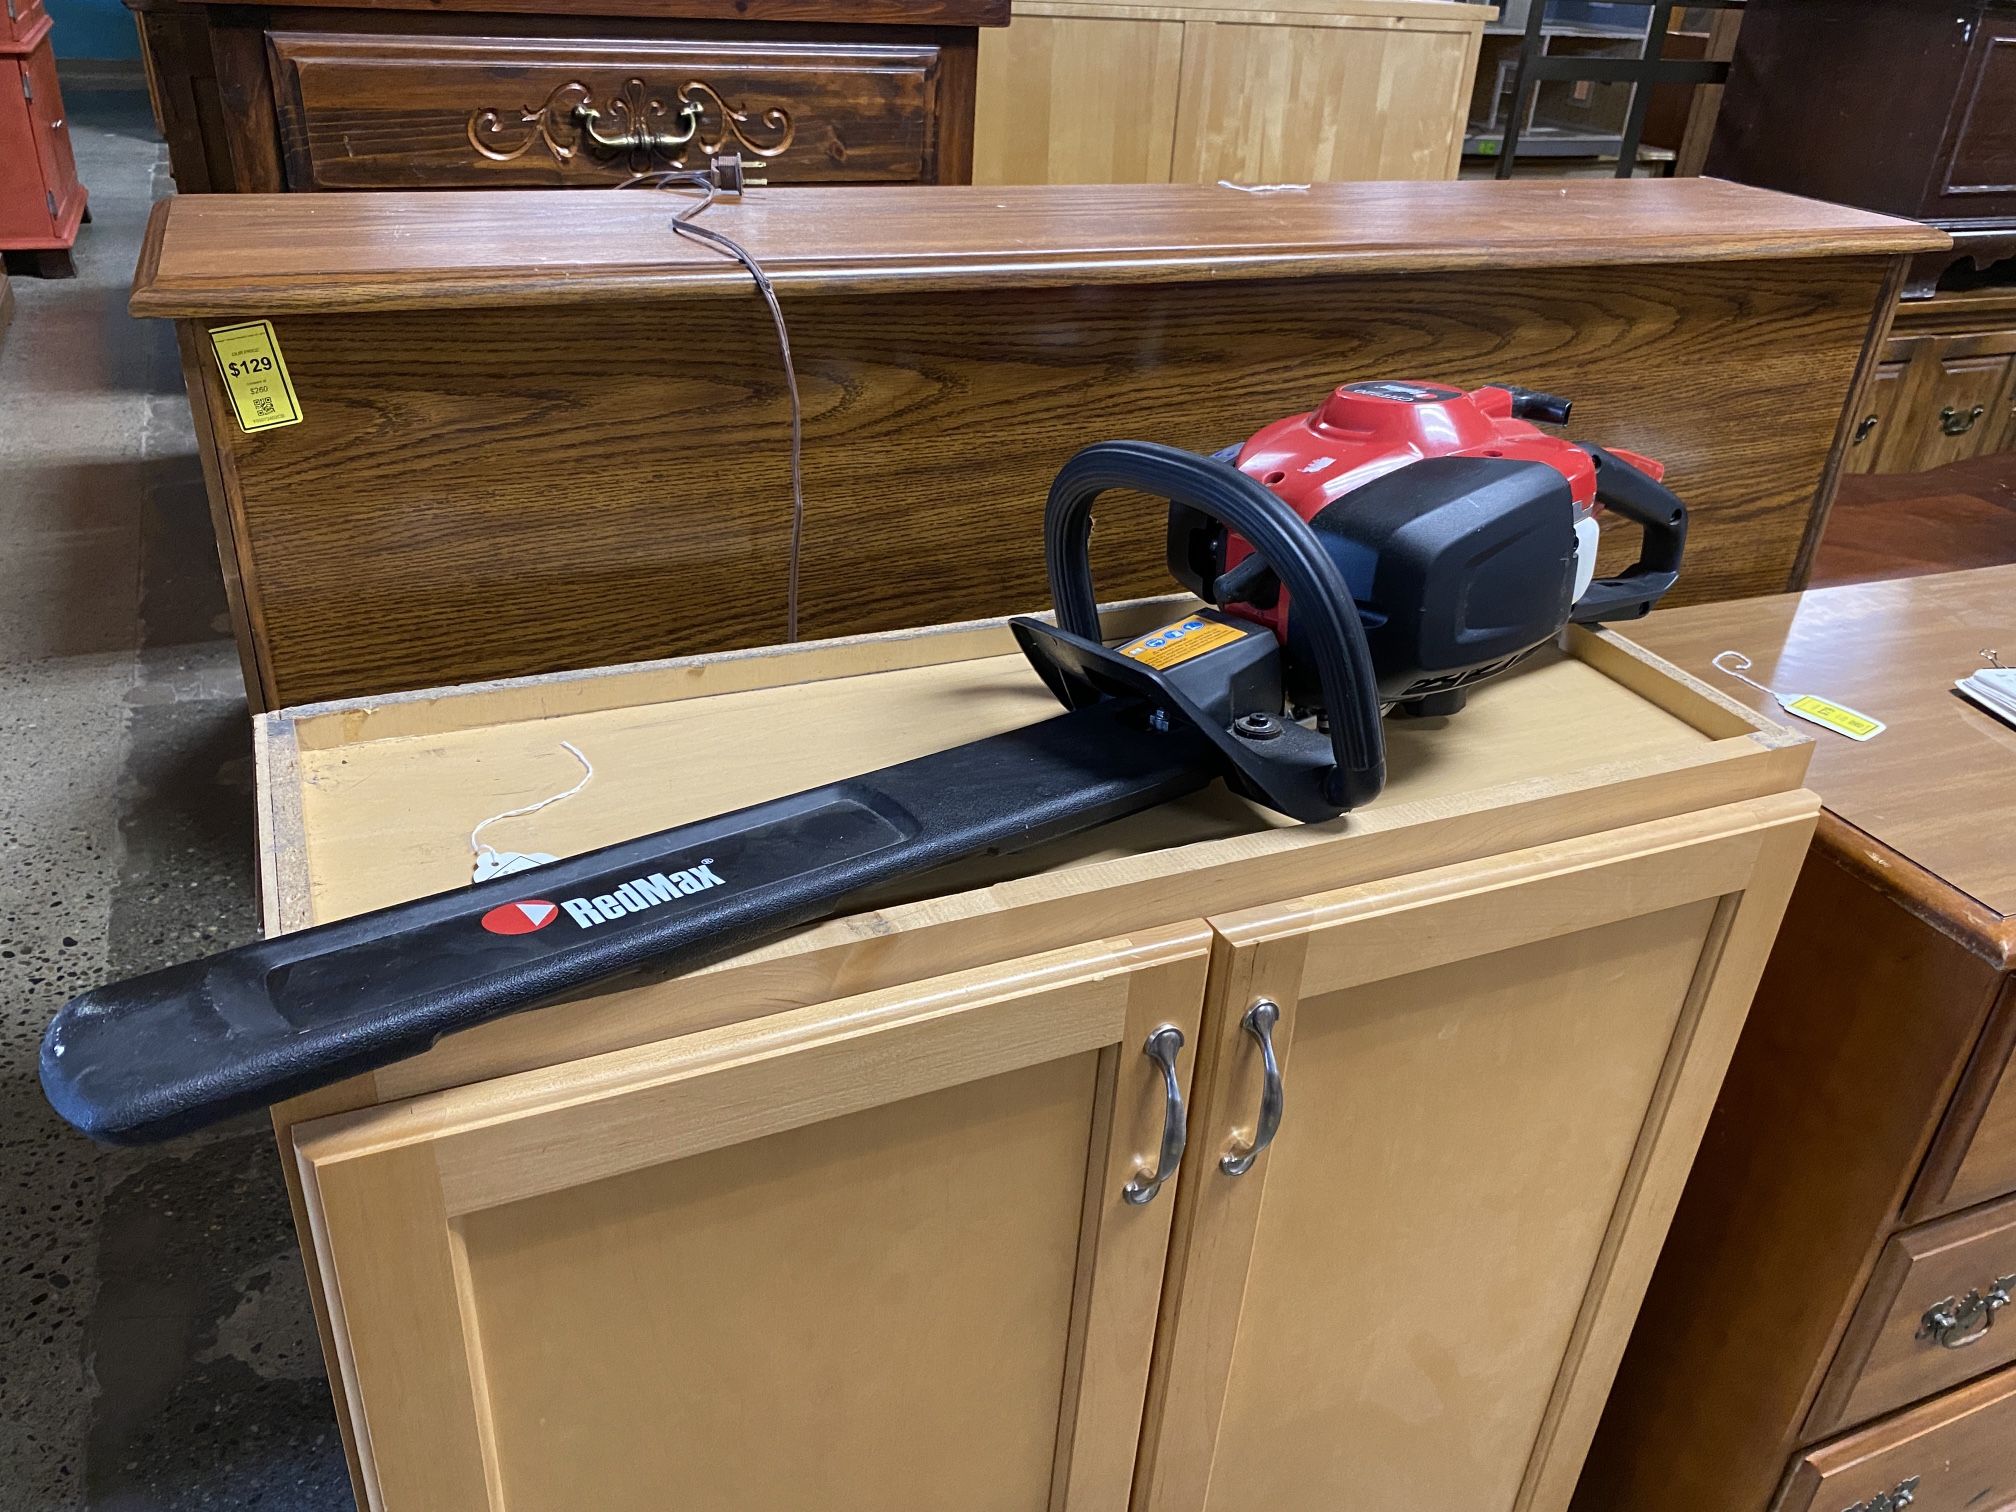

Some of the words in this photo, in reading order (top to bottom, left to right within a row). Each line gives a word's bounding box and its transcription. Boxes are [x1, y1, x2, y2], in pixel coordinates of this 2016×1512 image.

[228, 356, 272, 378] $129
[249, 385, 268, 395] $260
[561, 864, 726, 929] RedMax
